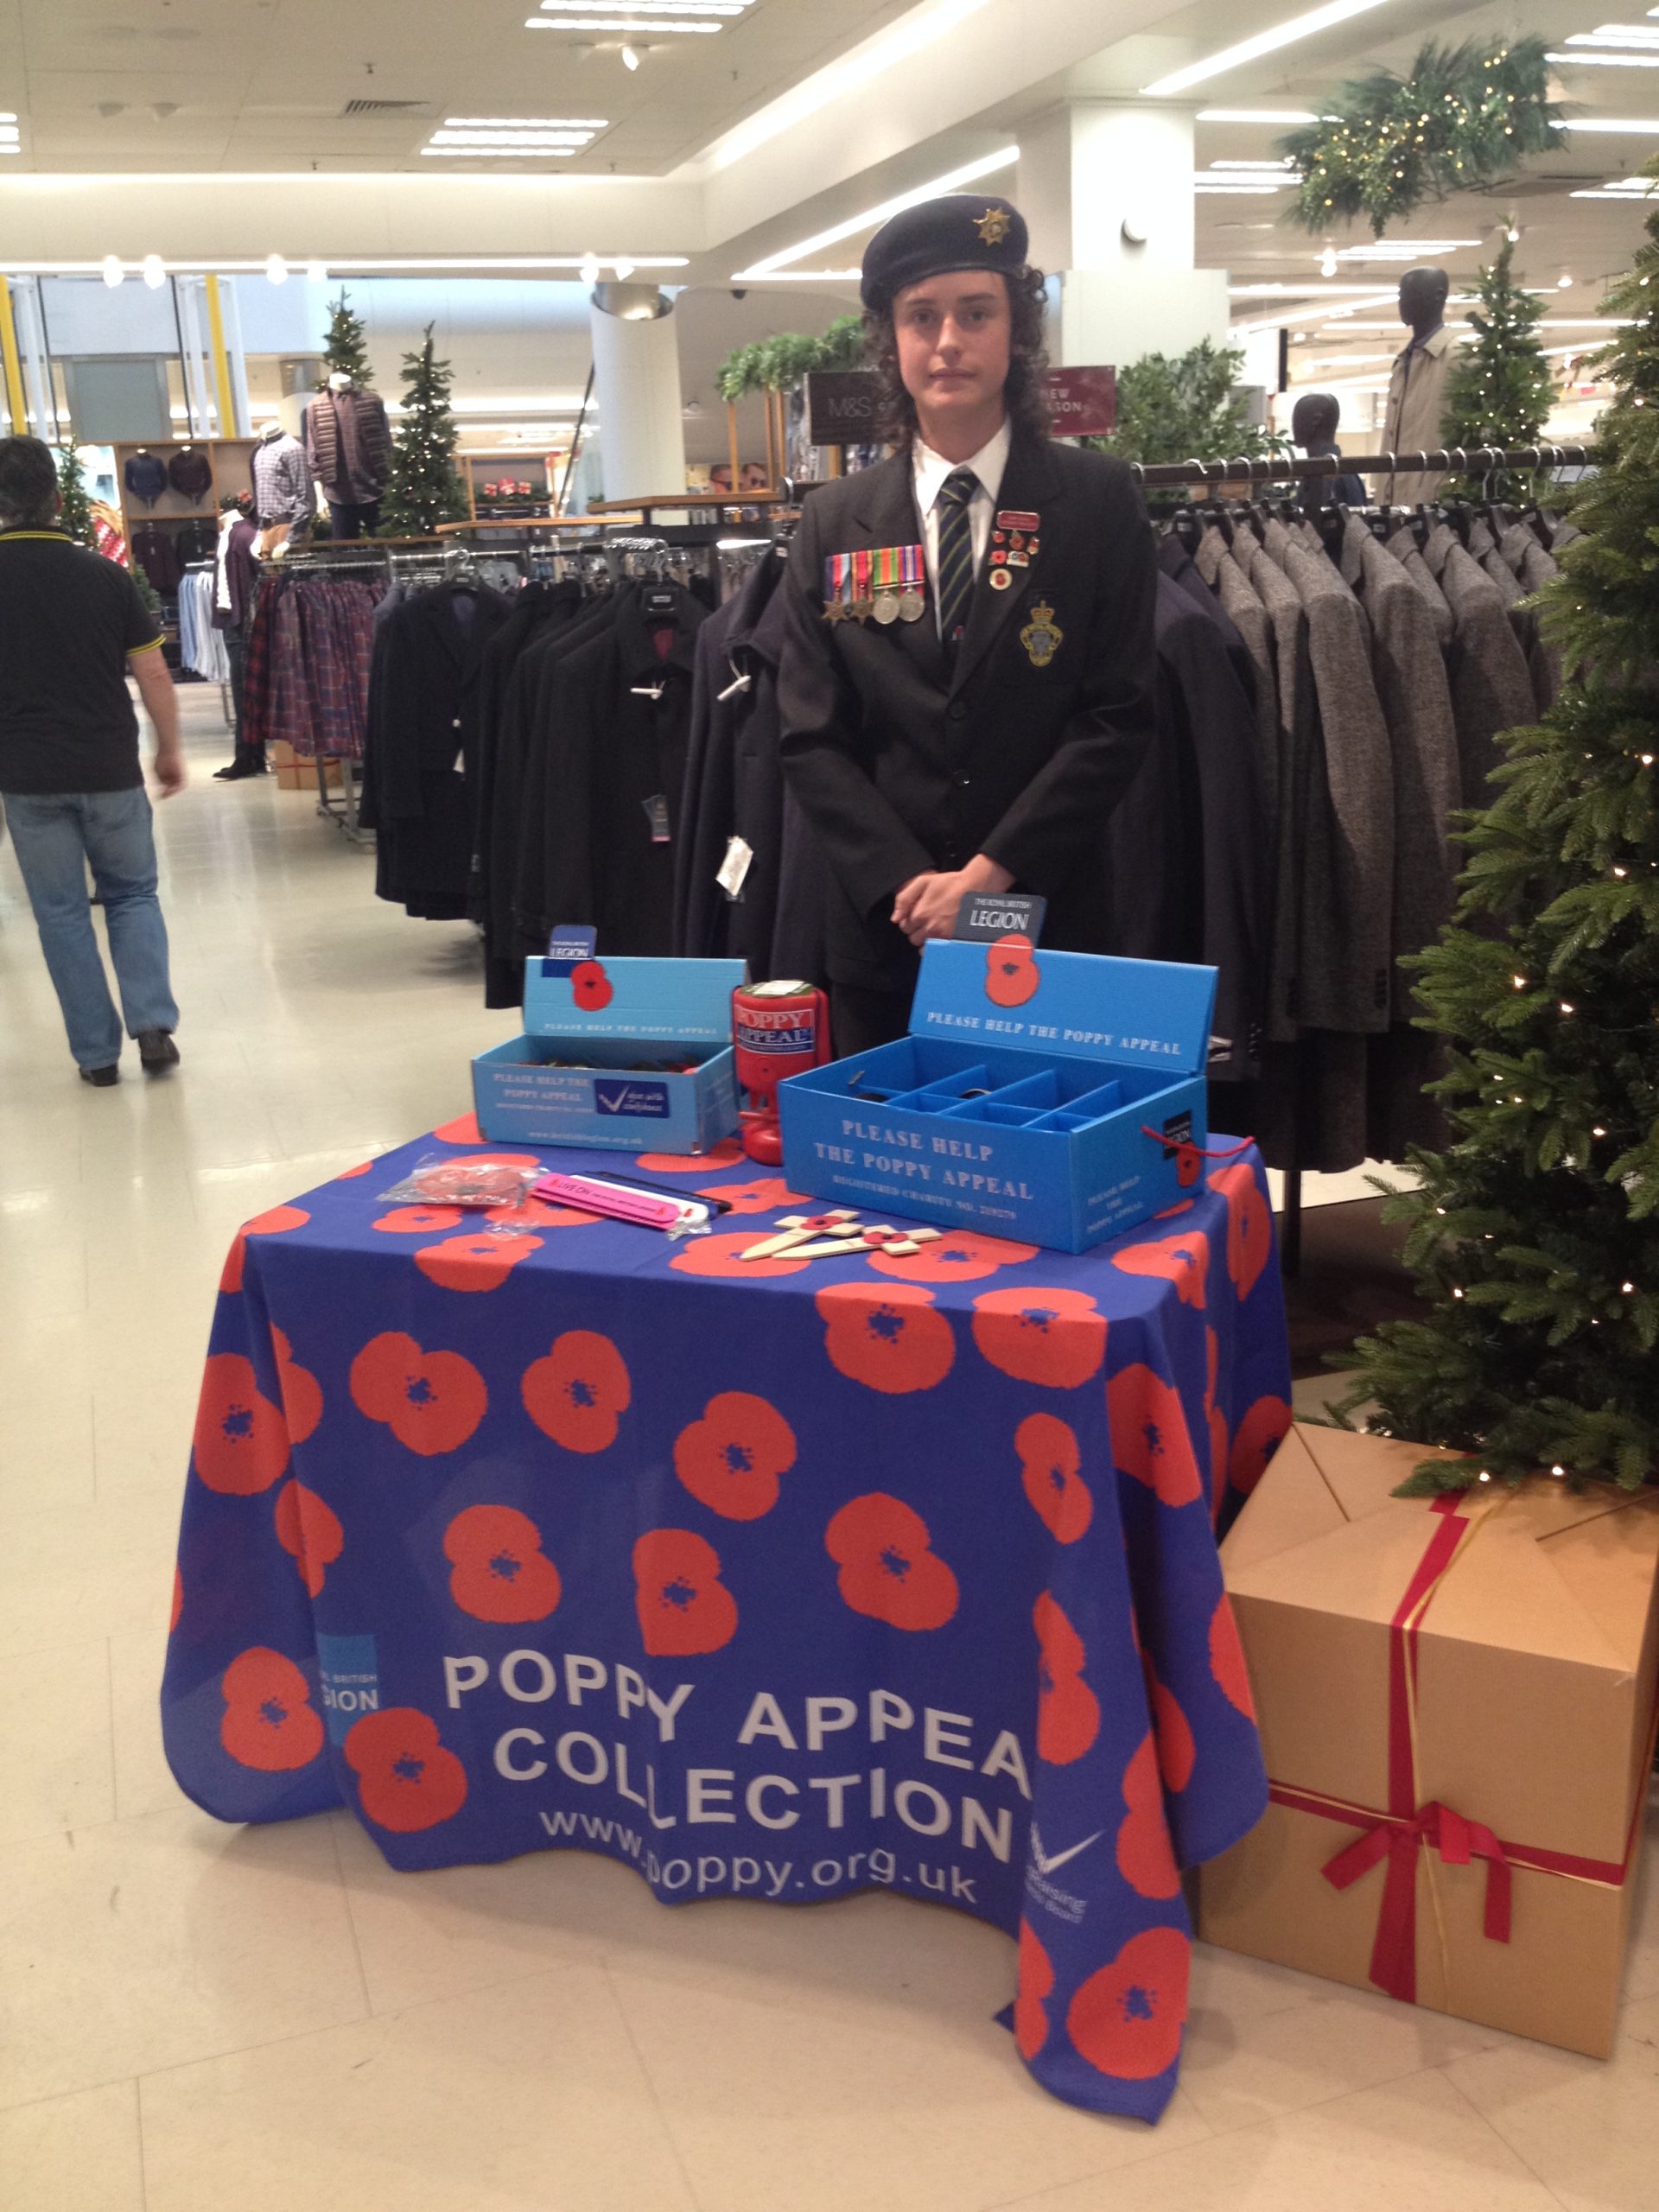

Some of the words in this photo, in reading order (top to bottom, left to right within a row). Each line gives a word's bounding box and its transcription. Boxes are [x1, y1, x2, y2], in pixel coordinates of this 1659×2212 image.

[969, 910, 1030, 931] LEGION
[926, 1012, 982, 1028] PLEASE
[984, 1019, 1024, 1034] HELP
[1028, 1025, 1058, 1039] THE
[1063, 1029, 1114, 1046] POPPY
[1119, 1037, 1182, 1055] APPEAL
[842, 1119, 925, 1150] PLEASE
[931, 1136, 994, 1162] HELP
[813, 1142, 855, 1165] THE
[862, 1153, 933, 1180] POPPY
[942, 1169, 1034, 1200] APPEAL
[442, 1649, 696, 1743] POPPY
[736, 1688, 1034, 1802] APPEA
[493, 1727, 1014, 1864] COLLECTION
[538, 1811, 978, 1904] www.poppy.org.uk
